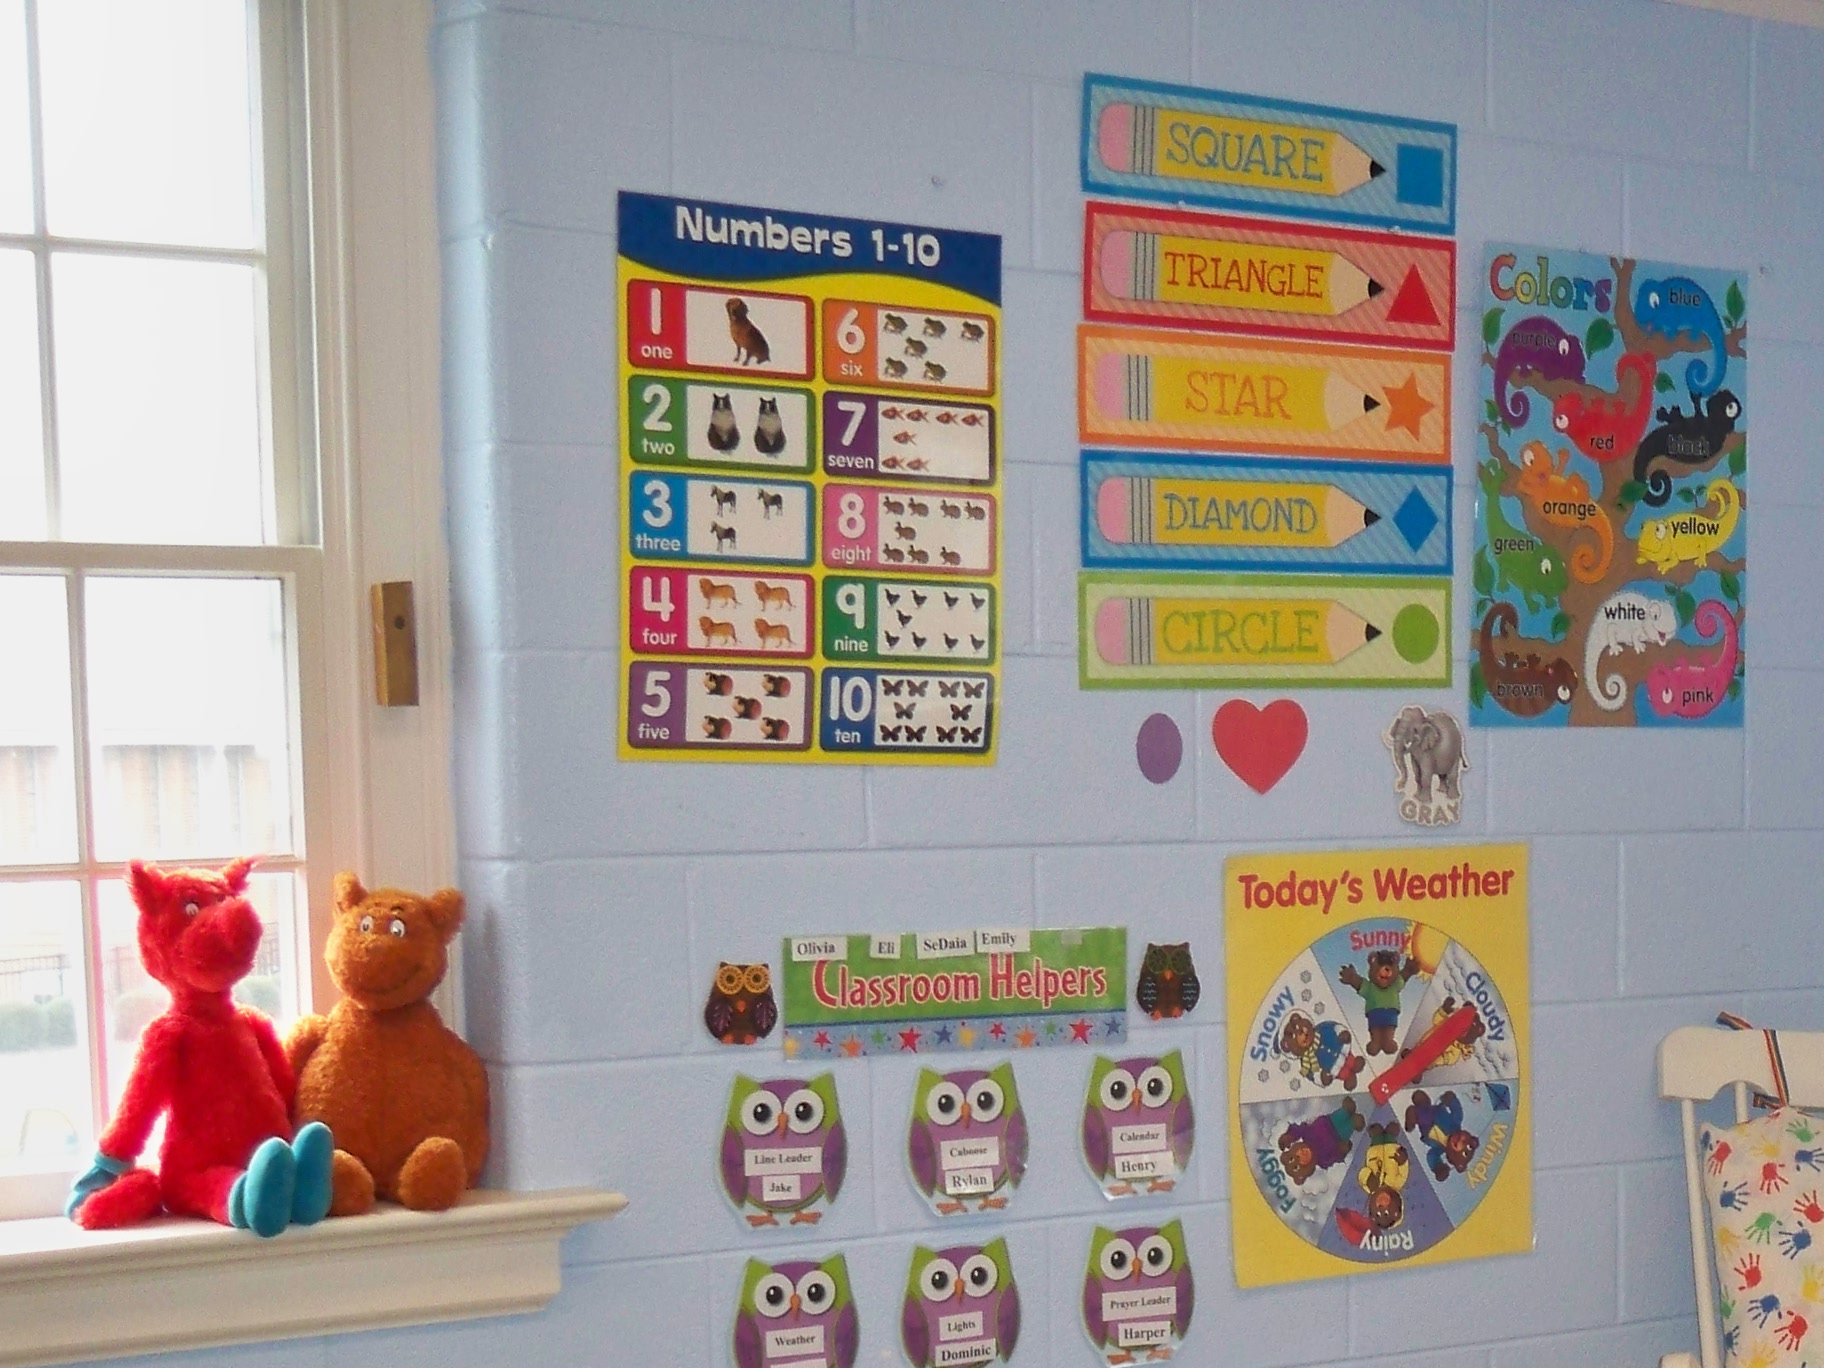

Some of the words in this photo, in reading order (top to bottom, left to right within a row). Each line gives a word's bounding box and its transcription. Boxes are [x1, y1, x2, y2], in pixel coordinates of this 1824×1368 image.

[1166, 121, 1326, 183] SQUARE
[675, 205, 853, 258] Numbers
[871, 229, 940, 268] 1-10
[1164, 250, 1325, 299] TRIANGLE
[1489, 253, 1613, 313] Colors
[1669, 288, 1701, 305] blue
[650, 287, 662, 335] 1
[837, 308, 865, 353] 6
[1512, 331, 1557, 348] purple
[641, 344, 673, 360] one
[841, 362, 863, 377] six
[1185, 370, 1292, 420] STAR
[642, 384, 673, 432] 2
[837, 400, 867, 447] 7
[641, 439, 675, 455] two
[1590, 435, 1615, 450] red
[1668, 435, 1709, 456] black
[828, 454, 874, 470] seven
[642, 480, 673, 528] 3
[1163, 493, 1318, 534] DIAMOND
[1543, 501, 1597, 520] orange
[838, 493, 866, 539] 8
[1671, 518, 1720, 537] yellow
[635, 533, 681, 552] three
[1494, 537, 1534, 555] green
[832, 546, 872, 564] eight
[642, 576, 675, 622] 4
[836, 583, 866, 630] 9
[1604, 602, 1646, 621] white
[642, 628, 677, 646] four
[1162, 609, 1319, 656] CIRCLE
[834, 637, 869, 652] nine
[641, 670, 672, 718] 5
[829, 676, 872, 722] 10
[1497, 683, 1544, 698] brown
[1682, 689, 1714, 707] pink
[638, 723, 670, 740] five
[835, 729, 861, 744] ten
[1399, 800, 1462, 825] GRAY
[1238, 871, 1364, 914] Today's
[1373, 863, 1515, 900] Weather
[796, 940, 836, 957] Olivia
[877, 941, 895, 955] Eli
[923, 936, 967, 953] SeDaia
[981, 930, 1017, 948] Emily
[1350, 930, 1412, 954] Sunny
[813, 960, 981, 1009] Classroom
[989, 951, 1108, 1009] Helpers
[1465, 970, 1506, 1043] Cloudy
[1250, 986, 1296, 1062] Snowy
[1120, 1130, 1160, 1142] Calendar
[754, 1155, 776, 1164] Line
[779, 1153, 813, 1164] Leader
[949, 1147, 988, 1158] Caboose
[1466, 1122, 1508, 1189] Windy
[1121, 1160, 1157, 1173] Henry
[769, 1182, 792, 1193] Jake
[952, 1174, 987, 1190] Rylan
[1257, 1147, 1297, 1213] Foggy
[1360, 1229, 1413, 1256] Rainy
[1110, 1300, 1138, 1311] Prayer
[1141, 1295, 1171, 1306] Leader
[947, 1321, 976, 1333] Lights
[1124, 1328, 1166, 1341] Harper
[775, 1335, 816, 1346] Weather
[941, 1345, 992, 1361] Dominic
